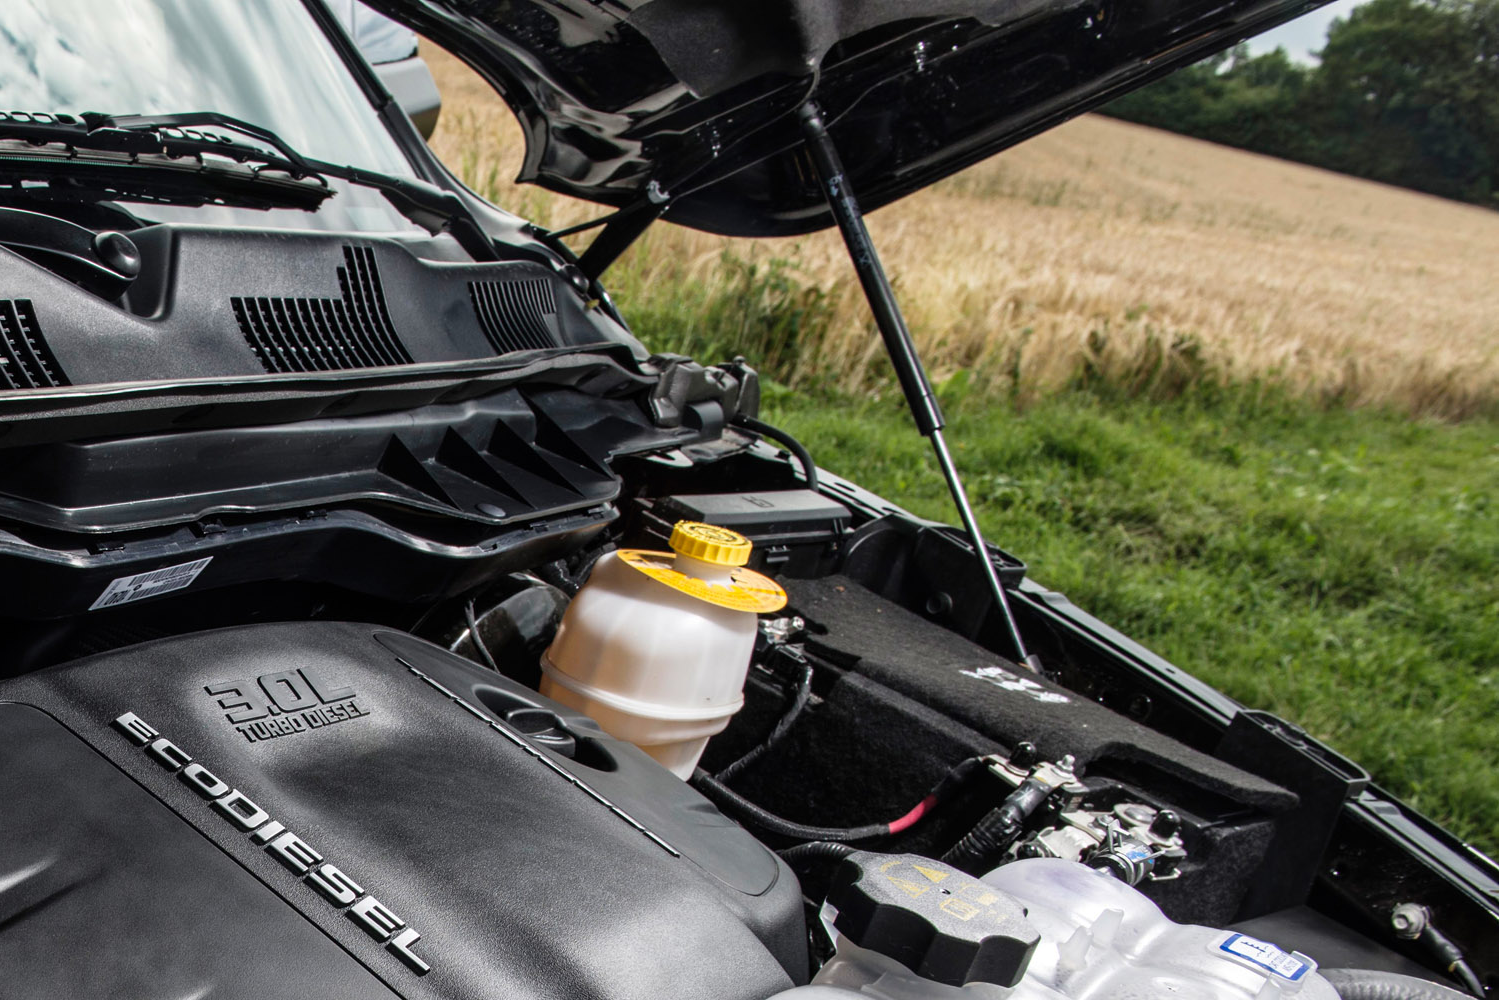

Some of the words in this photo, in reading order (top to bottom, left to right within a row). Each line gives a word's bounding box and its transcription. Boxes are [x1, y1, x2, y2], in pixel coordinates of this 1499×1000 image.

[203, 666, 357, 724] 3.0L
[236, 713, 307, 743] TURBO
[308, 699, 370, 729] DIESEL
[111, 711, 430, 976] ECODIESEL
